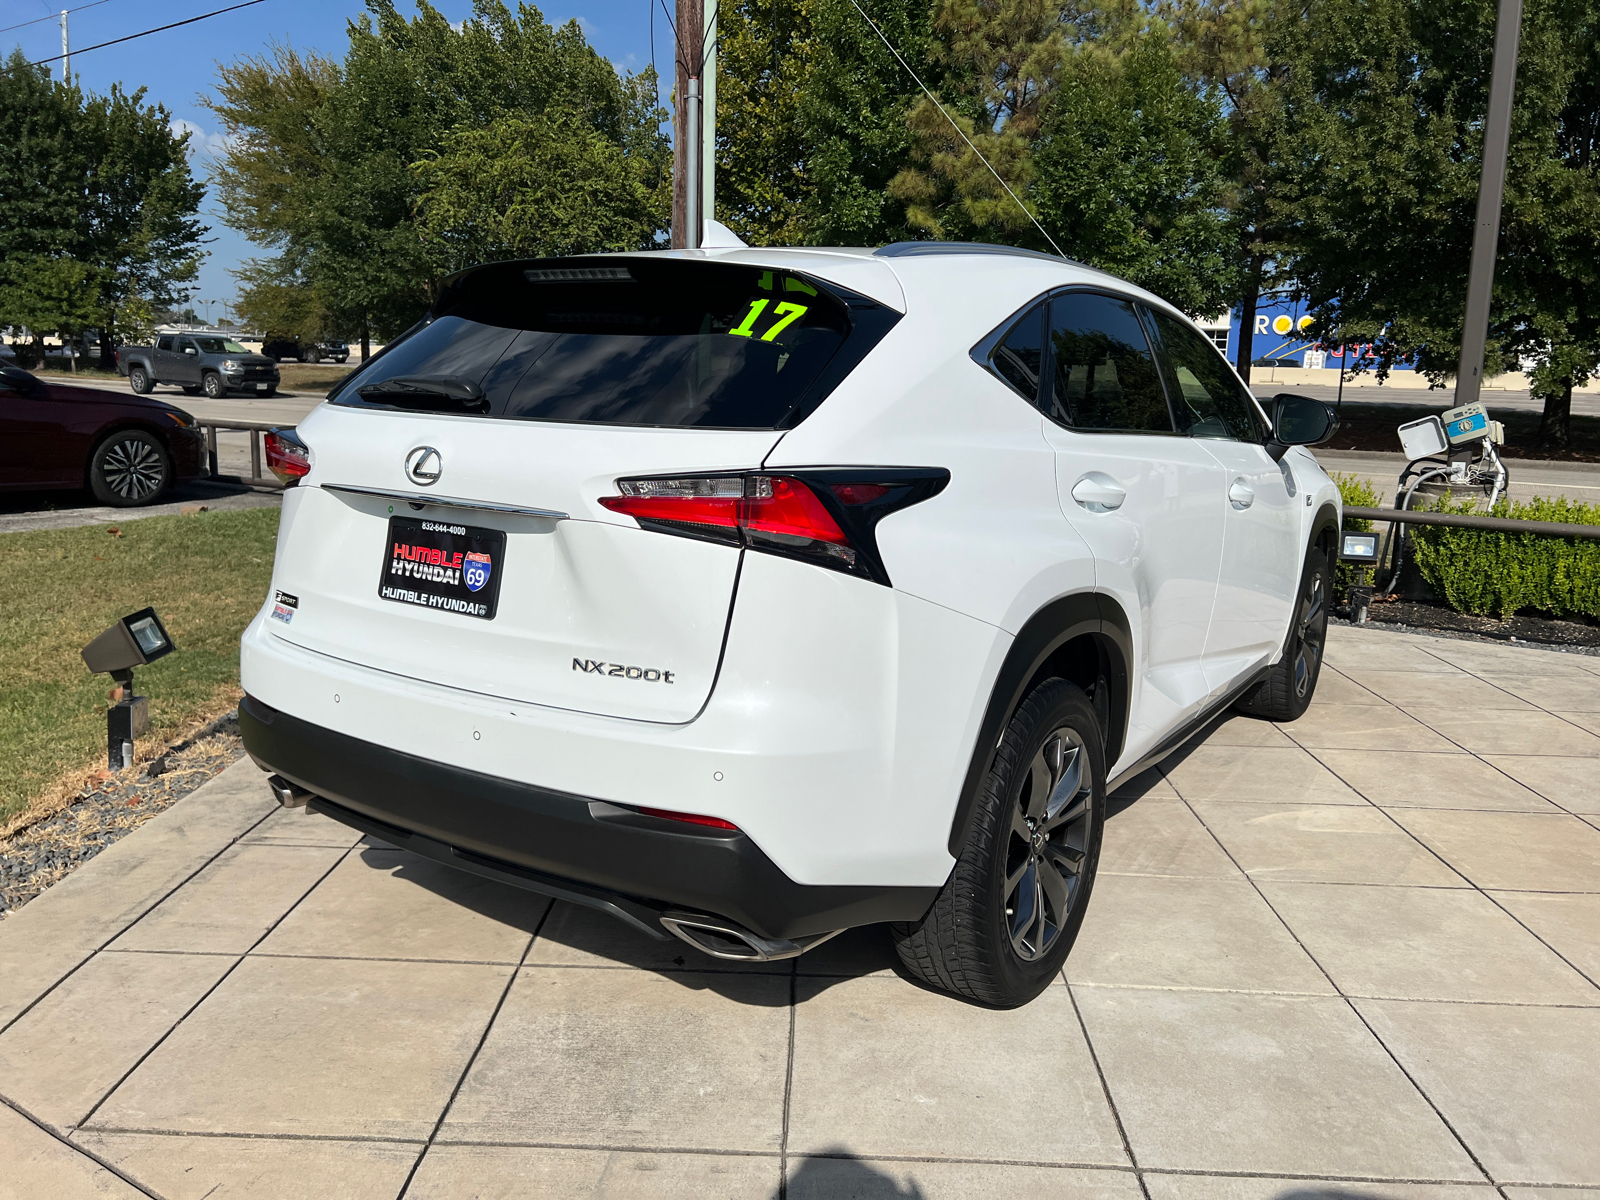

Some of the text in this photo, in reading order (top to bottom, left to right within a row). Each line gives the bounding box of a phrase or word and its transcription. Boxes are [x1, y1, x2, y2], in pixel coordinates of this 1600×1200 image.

[728, 298, 808, 342] 17
[421, 521, 466, 536] 832-644-4000
[393, 542, 464, 569] HUMBLE
[391, 559, 460, 586] HYUNDAI
[467, 568, 485, 587] 69
[382, 586, 479, 615] HUMBLE HYUNDAI
